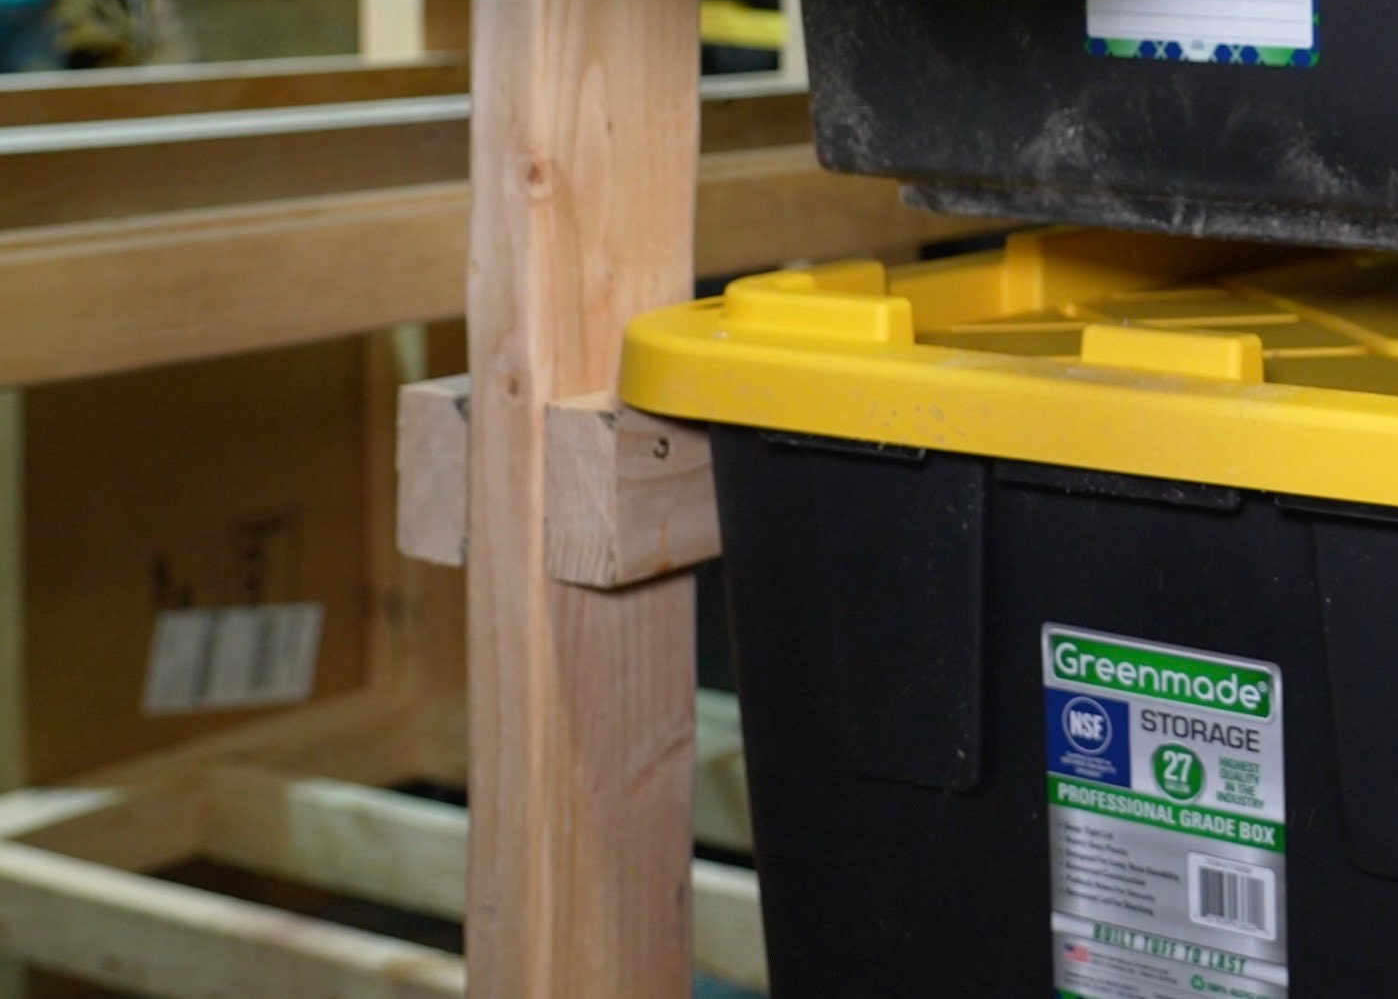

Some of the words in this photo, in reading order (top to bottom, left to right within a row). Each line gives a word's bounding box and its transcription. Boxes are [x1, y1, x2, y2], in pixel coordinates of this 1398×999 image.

[1069, 710, 1104, 741] NSF
[1141, 709, 1261, 753] STORAGE
[1163, 750, 1193, 783] 27
[1057, 782, 1176, 825] PROFESSIONAL
[1180, 809, 1236, 837] GRADE
[1239, 819, 1275, 846] BOX
[1093, 923, 1136, 947] BUILT
[1185, 945, 1202, 964] TO
[1208, 951, 1247, 975] LAST
